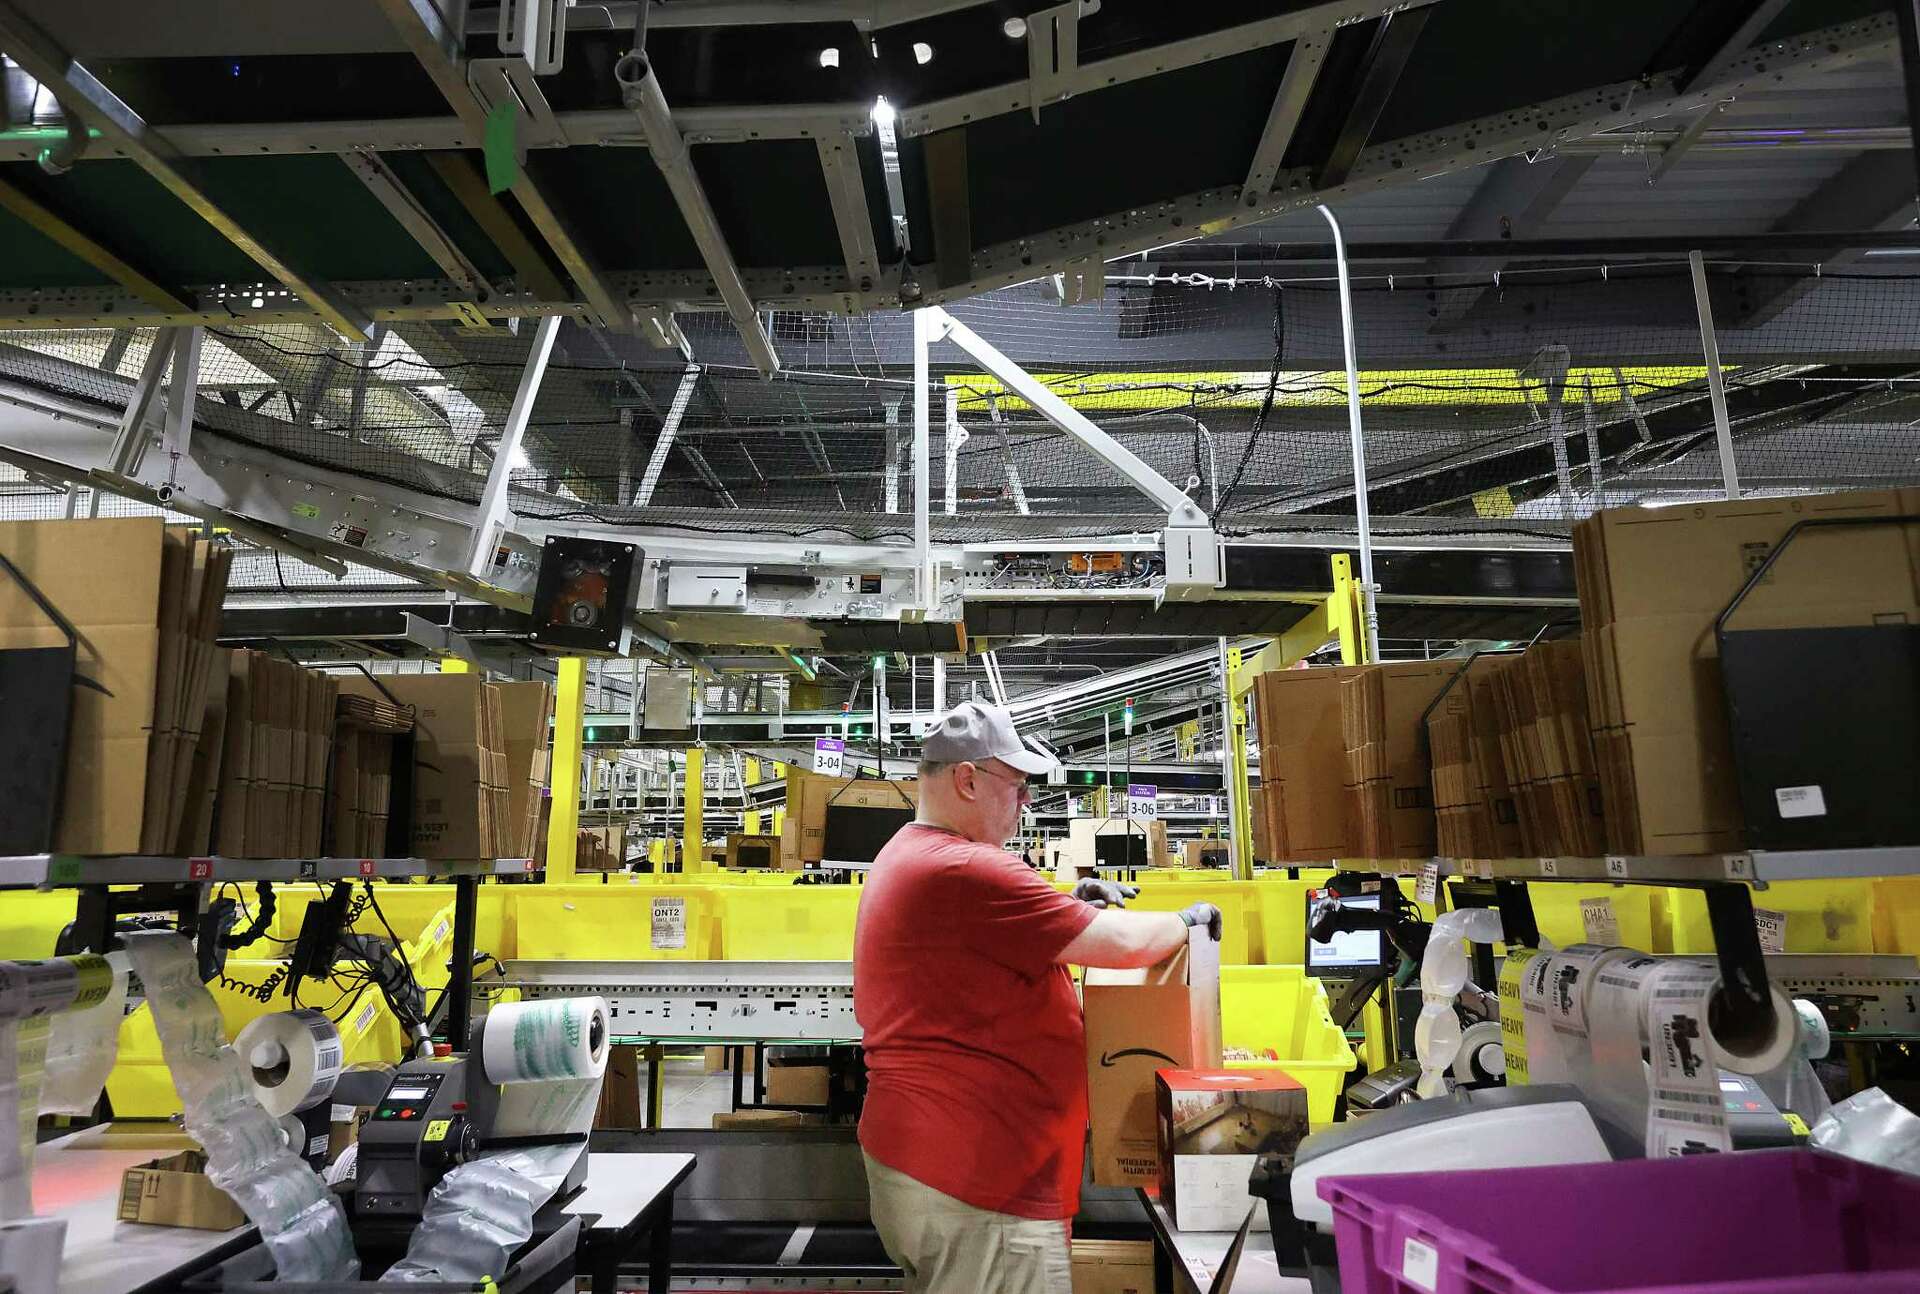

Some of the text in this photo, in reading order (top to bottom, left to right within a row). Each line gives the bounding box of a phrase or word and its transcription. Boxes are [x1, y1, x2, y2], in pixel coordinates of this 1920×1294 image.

[816, 755, 840, 769] 3-04
[1131, 802, 1155, 815] 3-06
[195, 864, 207, 876] 20
[1544, 861, 1554, 872] A5
[1611, 861, 1622, 873] A6
[1730, 859, 1745, 873] A7
[654, 908, 680, 917] ONT2
[1499, 981, 1521, 1000] HEAVY
[1501, 1016, 1524, 1036] HEAVY
